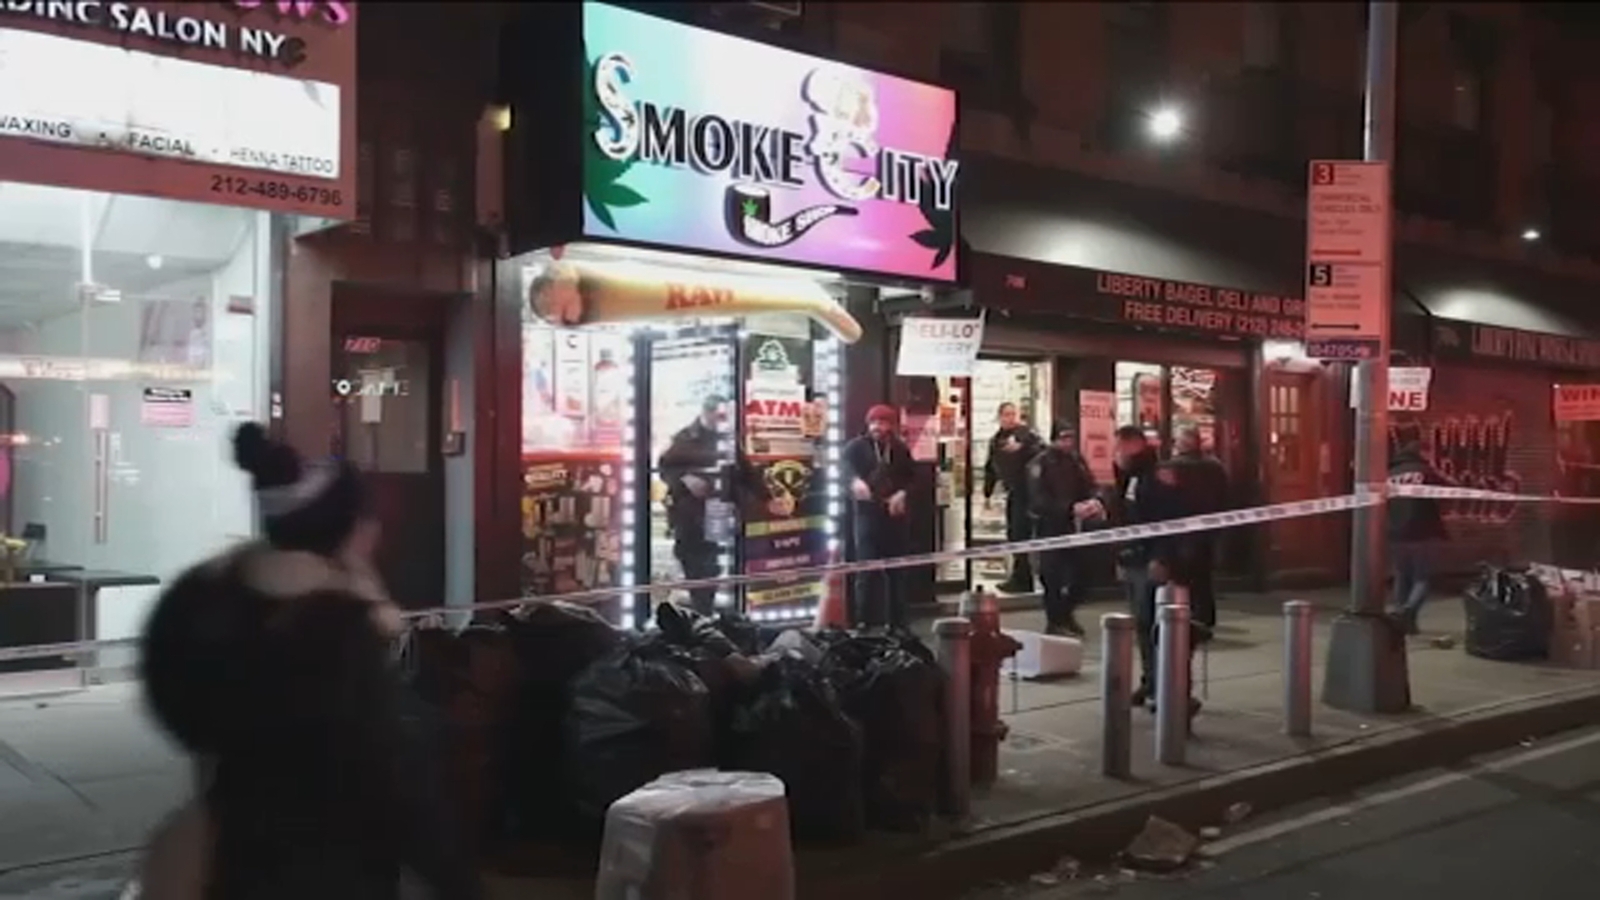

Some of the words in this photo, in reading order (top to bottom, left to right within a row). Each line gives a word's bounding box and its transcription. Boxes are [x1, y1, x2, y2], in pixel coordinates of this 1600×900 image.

[110, 2, 226, 48] SALON
[128, 132, 195, 156] FACIAL
[1318, 164, 1331, 183] 3
[210, 174, 342, 206] 212-489-6796
[1314, 266, 1329, 285] 5
[1097, 273, 1160, 299] LIBERTY
[1165, 281, 1213, 306] BAGEL
[1217, 289, 1249, 310] DELI
[1252, 295, 1280, 314] AND
[1125, 300, 1163, 323] FREE
[1165, 306, 1233, 330] DELIVERY
[746, 400, 801, 417] ATM
[1390, 391, 1423, 408] NE
